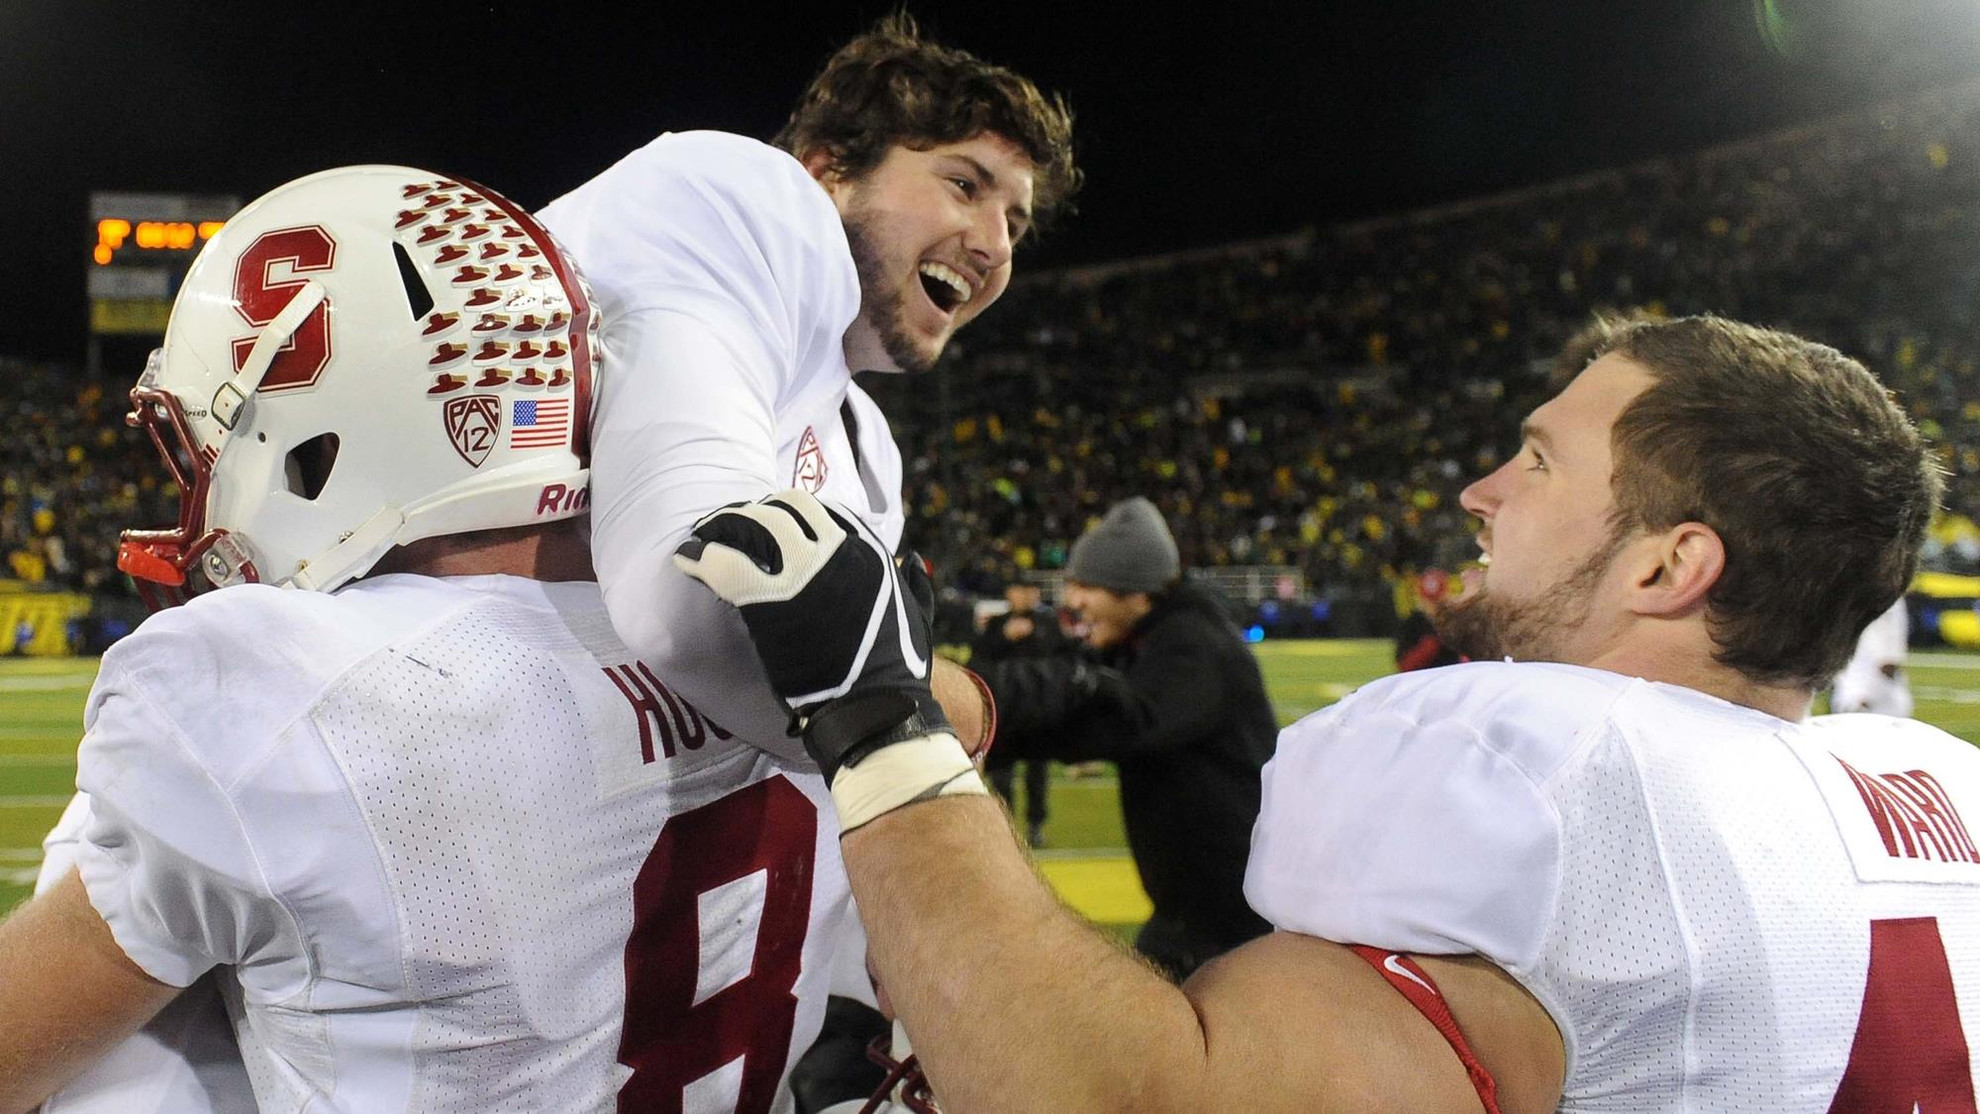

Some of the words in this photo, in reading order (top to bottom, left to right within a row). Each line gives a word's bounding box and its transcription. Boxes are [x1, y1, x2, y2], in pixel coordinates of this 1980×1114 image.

[231, 224, 337, 393] S
[449, 398, 499, 440] PAC
[463, 426, 490, 453] 12
[601, 659, 734, 766] HU
[1828, 751, 1980, 864] WARD
[617, 773, 818, 1114] 8
